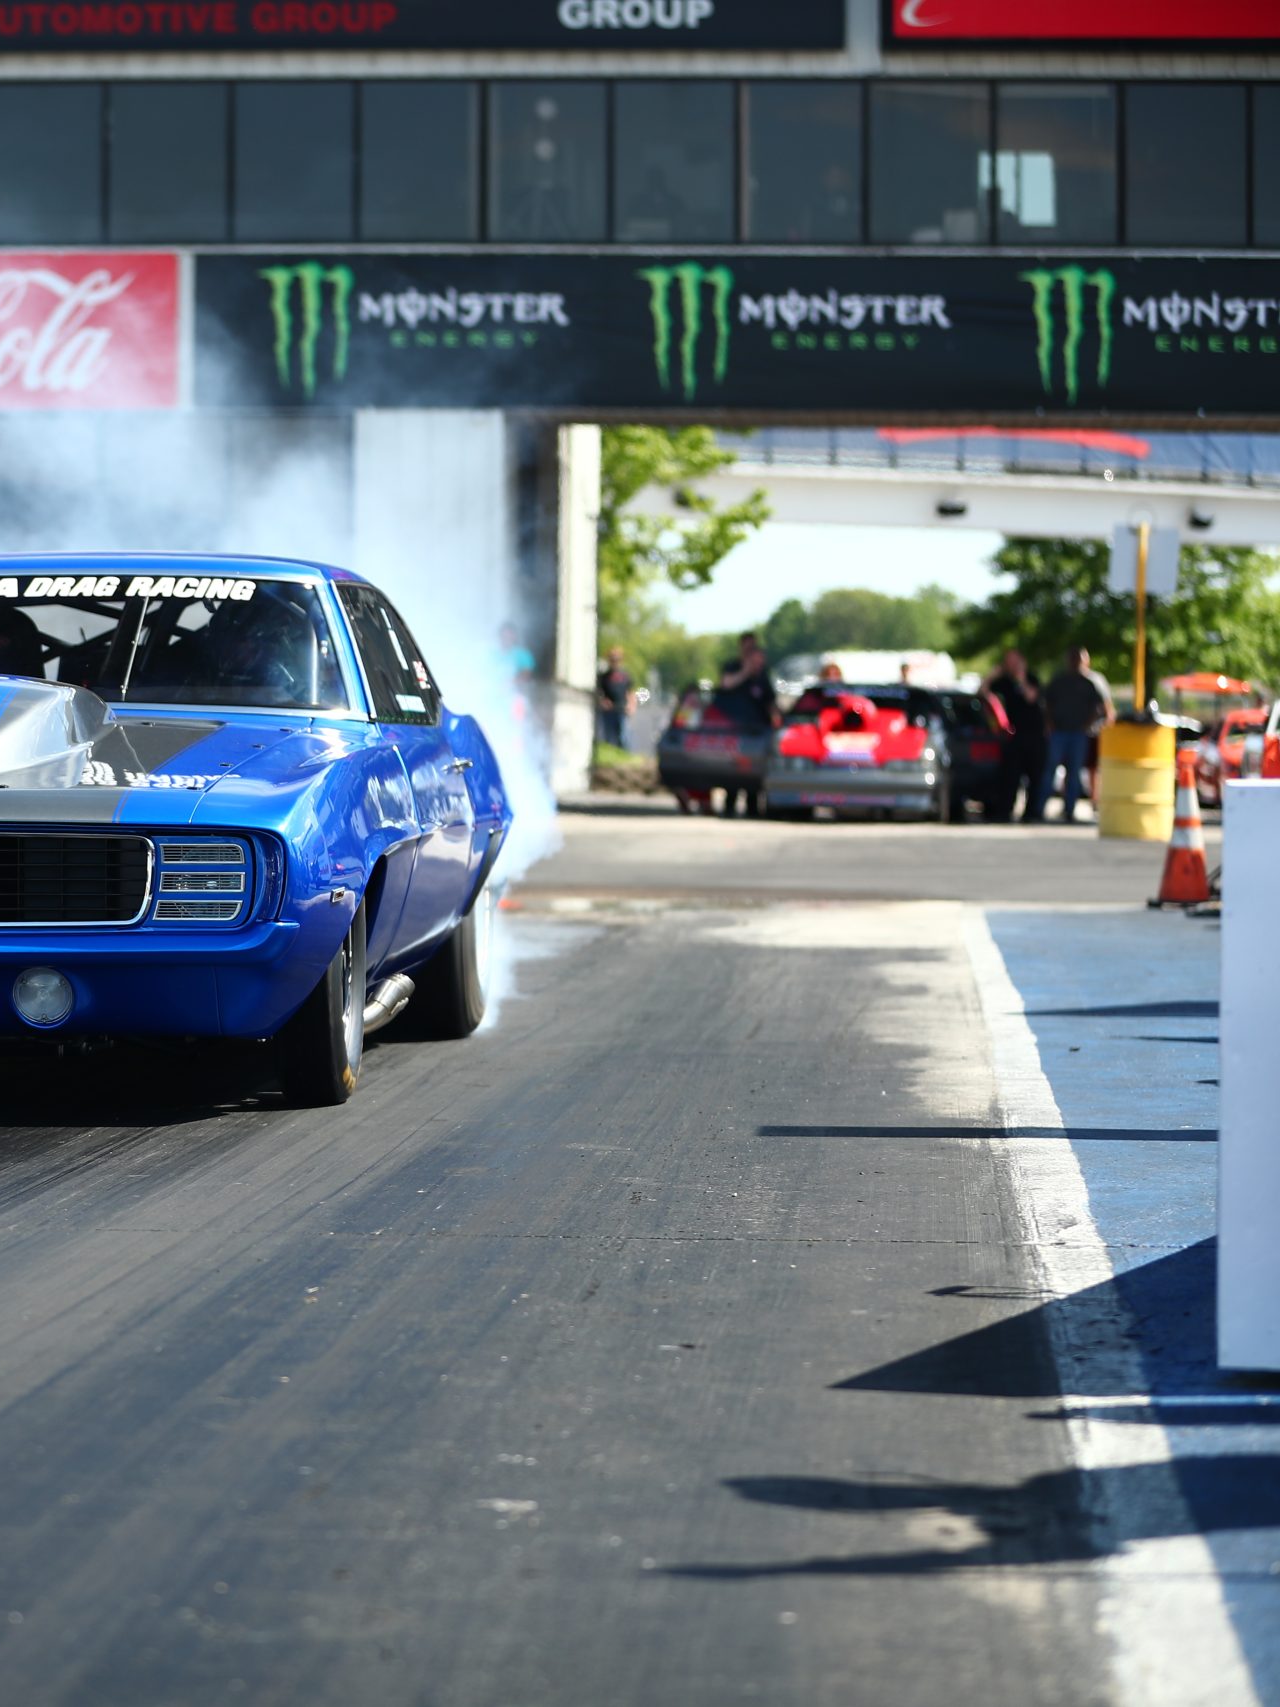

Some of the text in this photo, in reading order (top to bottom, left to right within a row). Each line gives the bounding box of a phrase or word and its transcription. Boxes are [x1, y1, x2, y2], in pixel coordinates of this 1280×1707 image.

[251, 2, 397, 34] GROUP
[558, 0, 714, 29] GROUP
[358, 287, 571, 327] MONSTER
[737, 287, 950, 327] MONSTER
[1122, 289, 1280, 333] MONST
[389, 329, 539, 349] ENERGY
[768, 329, 918, 349] ENERGY
[23, 576, 120, 598] DRAG
[125, 576, 257, 601] RACING
